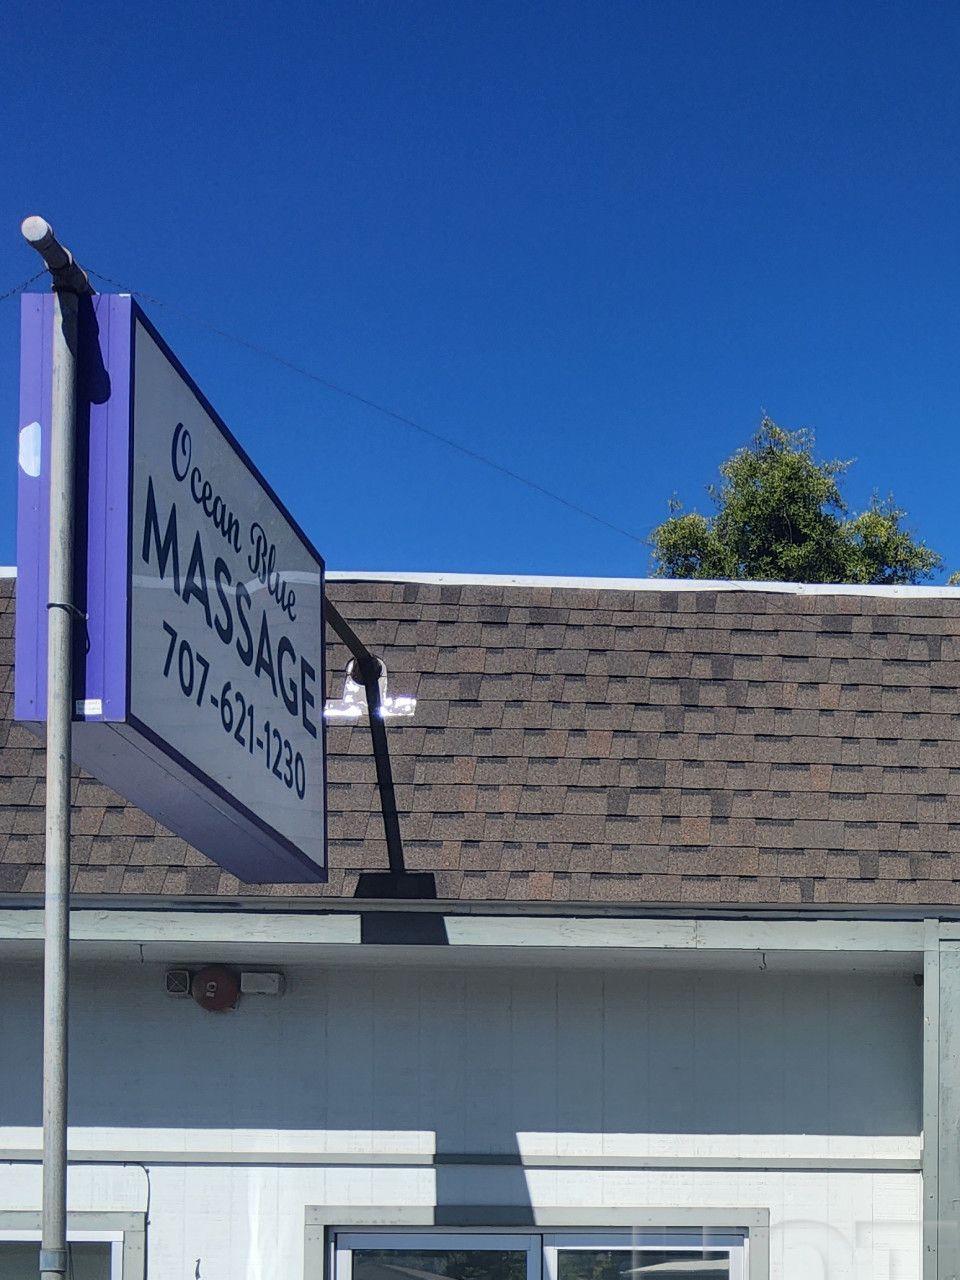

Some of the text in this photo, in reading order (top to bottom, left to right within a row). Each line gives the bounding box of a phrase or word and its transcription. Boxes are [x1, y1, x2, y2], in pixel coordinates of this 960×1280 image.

[142, 474, 318, 740] MASSAGE
[171, 422, 297, 622] Ocean Blue
[163, 620, 306, 801] 707-621-1230
